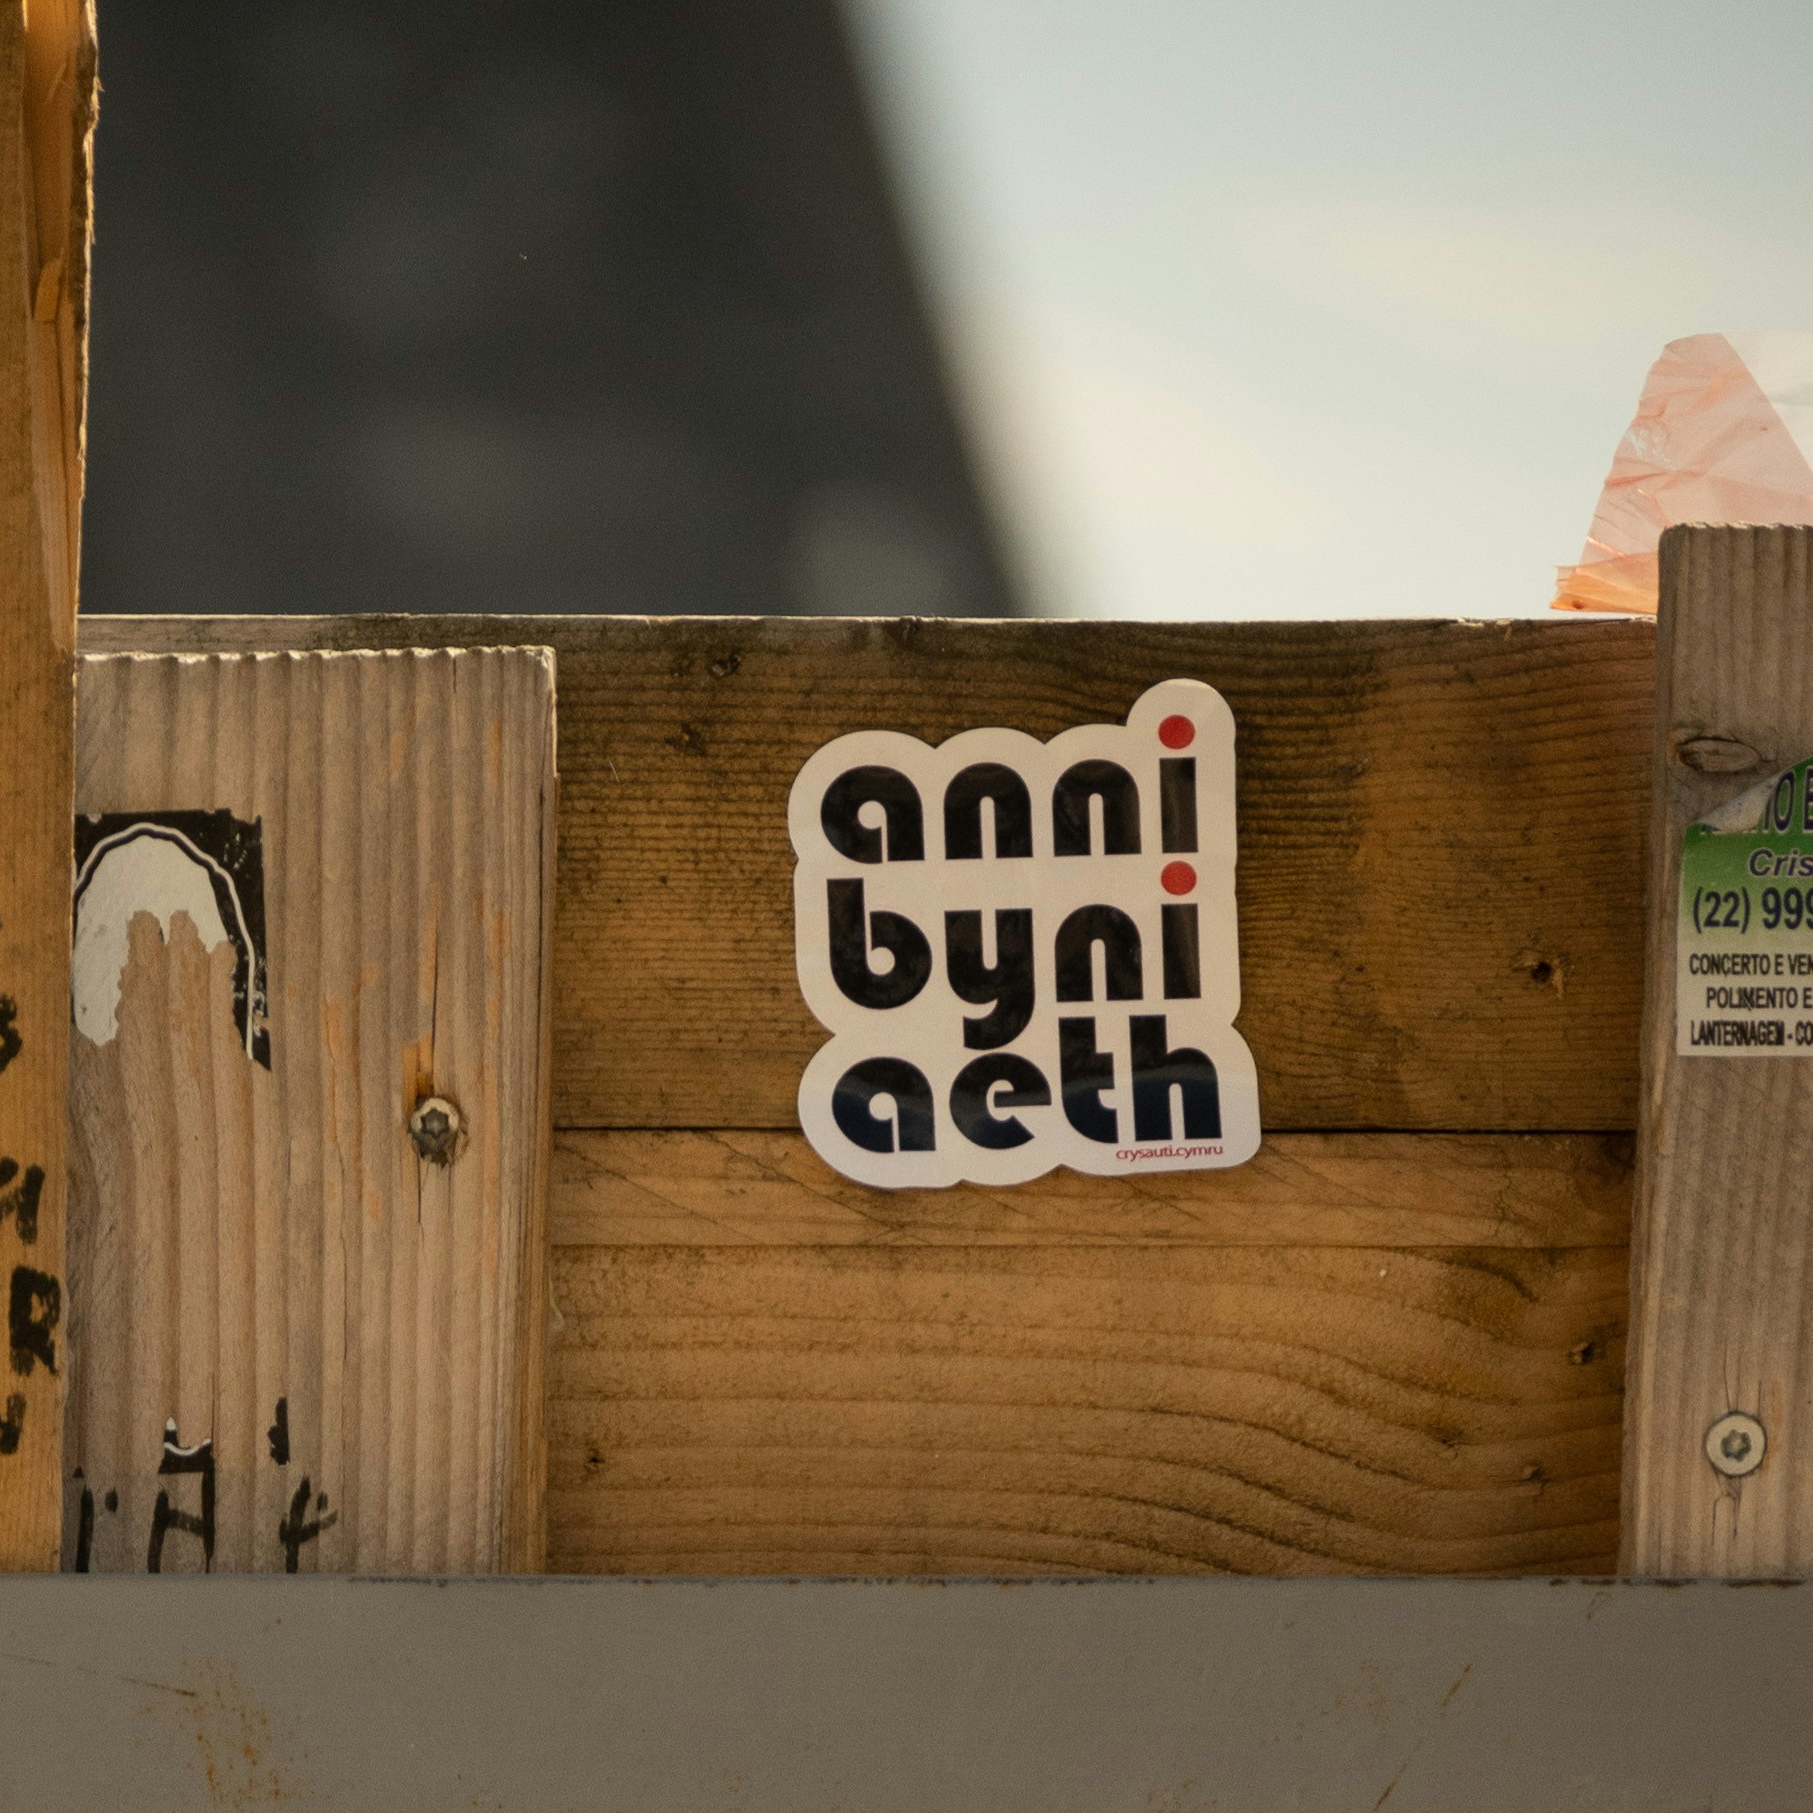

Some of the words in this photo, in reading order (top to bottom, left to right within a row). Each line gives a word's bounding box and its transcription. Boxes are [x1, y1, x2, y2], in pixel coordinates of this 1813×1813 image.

[820, 714, 1199, 865] anni
[826, 860, 1202, 1051] byni
[1693, 886, 1751, 934] (22)
[831, 1014, 1223, 1154] aeth
[1115, 1143, 1224, 1162] crysauti.cymru
